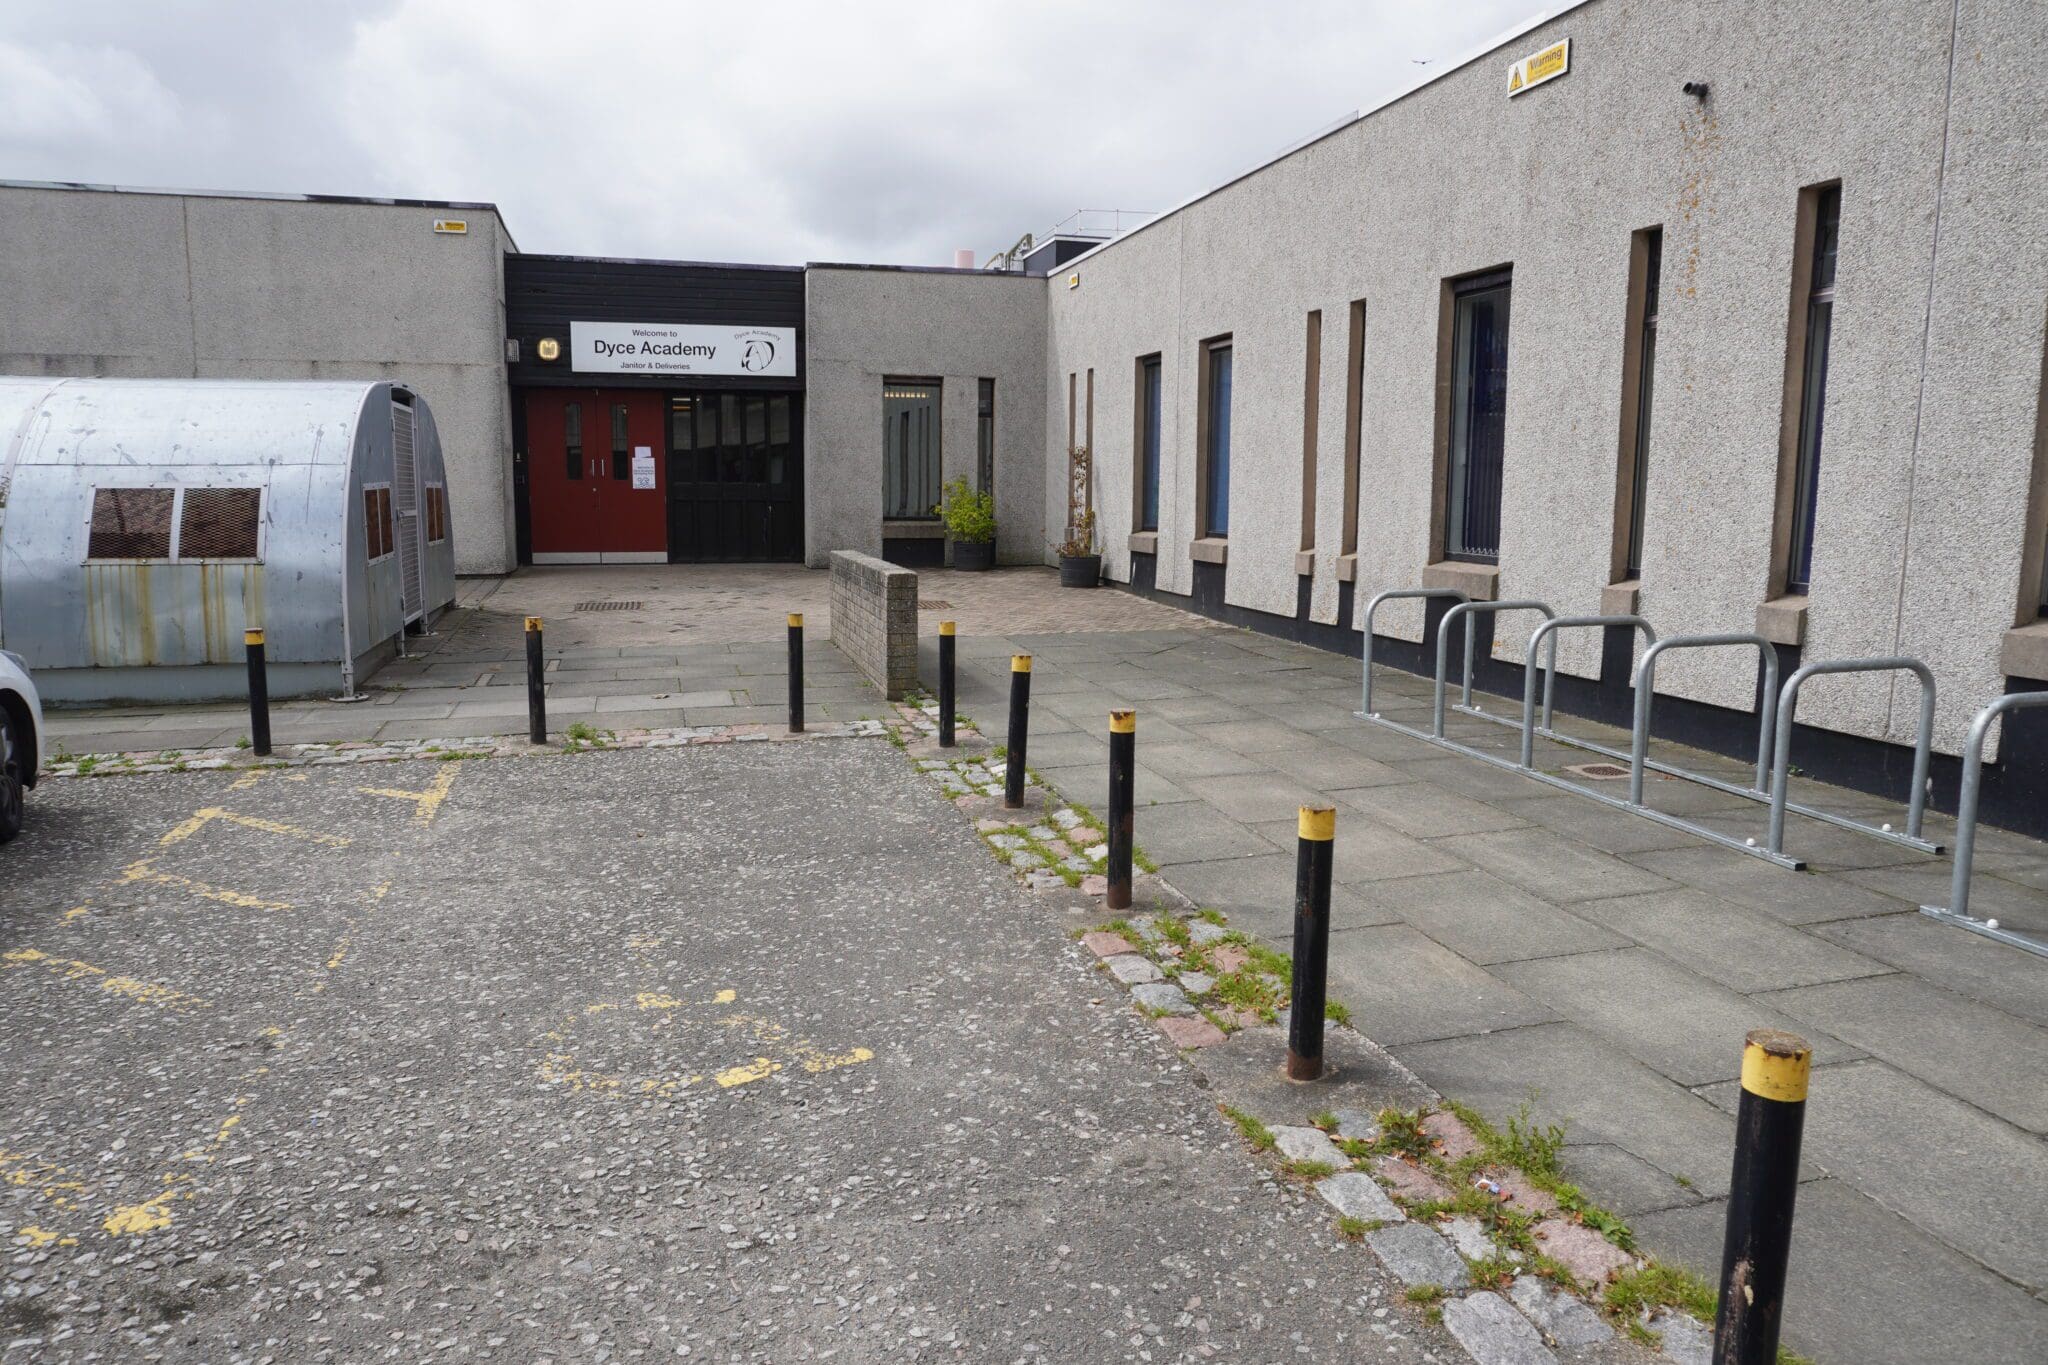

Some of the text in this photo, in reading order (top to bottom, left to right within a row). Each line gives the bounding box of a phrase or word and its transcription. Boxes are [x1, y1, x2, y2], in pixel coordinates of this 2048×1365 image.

[1530, 49, 1562, 70] Warning
[632, 329, 678, 338] Welcome to
[594, 339, 717, 360] Dyce Academy
[655, 362, 691, 370] Deliveries
